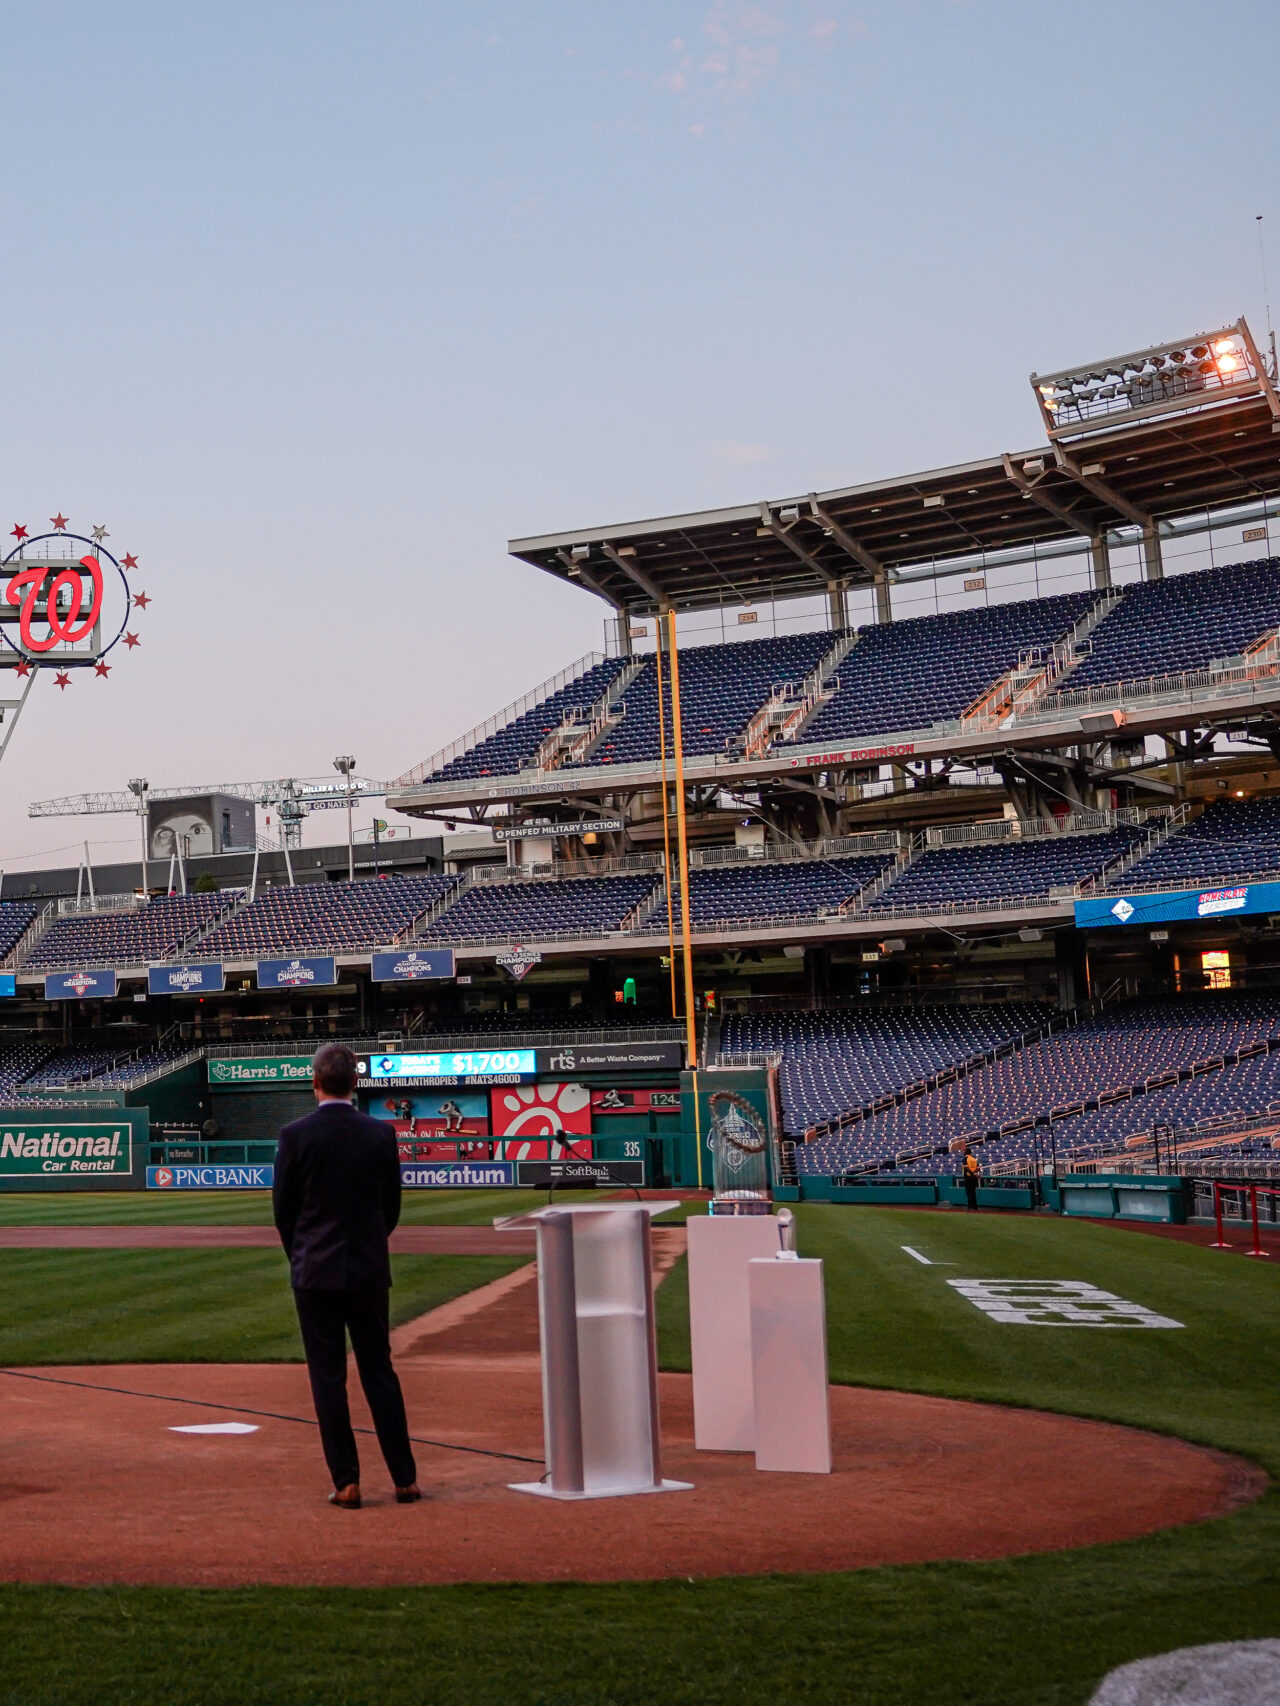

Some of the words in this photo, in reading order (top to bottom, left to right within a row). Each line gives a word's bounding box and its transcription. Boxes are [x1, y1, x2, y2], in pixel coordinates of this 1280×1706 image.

[806, 752, 847, 766] FRANK
[851, 744, 915, 761] ROBINSON
[302, 785, 328, 794] MILLER
[504, 783, 564, 796] ROBINSON
[313, 802, 326, 810] GO
[542, 824, 581, 834] MILITARY
[582, 820, 620, 831] SECTION
[495, 957, 542, 965] CHAMPIONS
[394, 964, 431, 973] CHAMPIONS
[278, 970, 315, 982] CHAMPIONS
[453, 1053, 520, 1075] $1,700
[550, 1053, 576, 1070] rts
[629, 1054, 660, 1063] Company
[230, 1065, 277, 1079] Harris
[280, 1063, 314, 1077] Teet
[391, 1076, 458, 1087] PHILANTHROPIES
[464, 1074, 521, 1085] #NATS4GOOD
[1, 1130, 120, 1158] National
[623, 1141, 640, 1157] 335
[42, 1160, 64, 1171] Car
[68, 1159, 115, 1171] Rental
[566, 1166, 608, 1177] SoftBank
